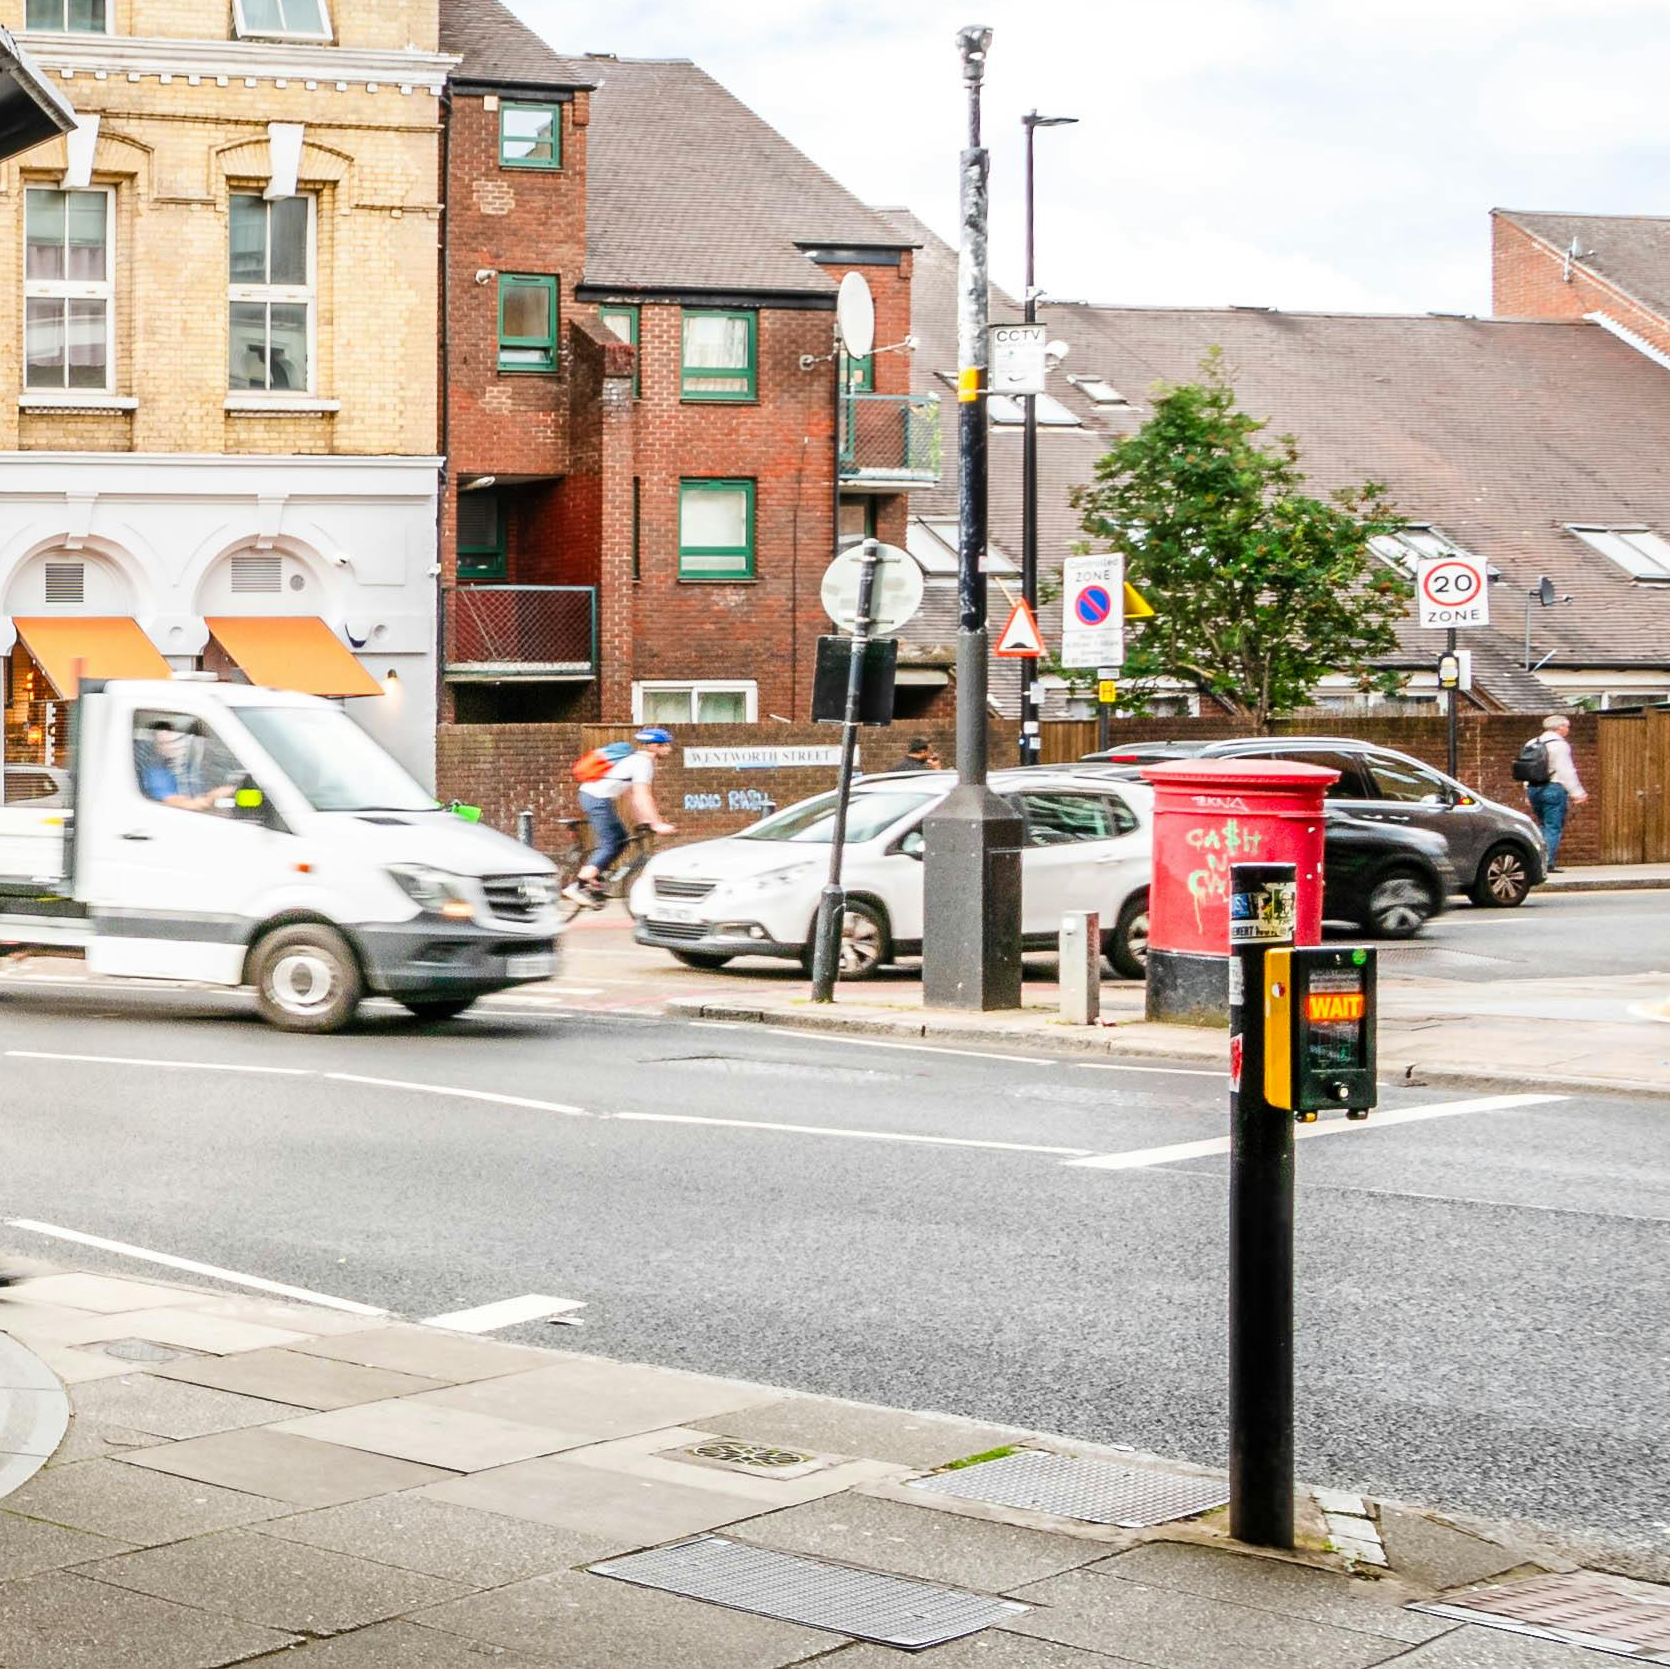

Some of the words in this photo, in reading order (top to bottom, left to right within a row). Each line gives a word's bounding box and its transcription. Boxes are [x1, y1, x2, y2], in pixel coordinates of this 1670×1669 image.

[996, 330, 1040, 342] CCTV
[1076, 570, 1110, 582] ZONE
[1433, 574, 1472, 593] 20
[1428, 609, 1481, 623] ZONE
[691, 751, 778, 763] WENTWORTH
[782, 750, 830, 762] STREET
[1309, 997, 1360, 1019] WAIT
